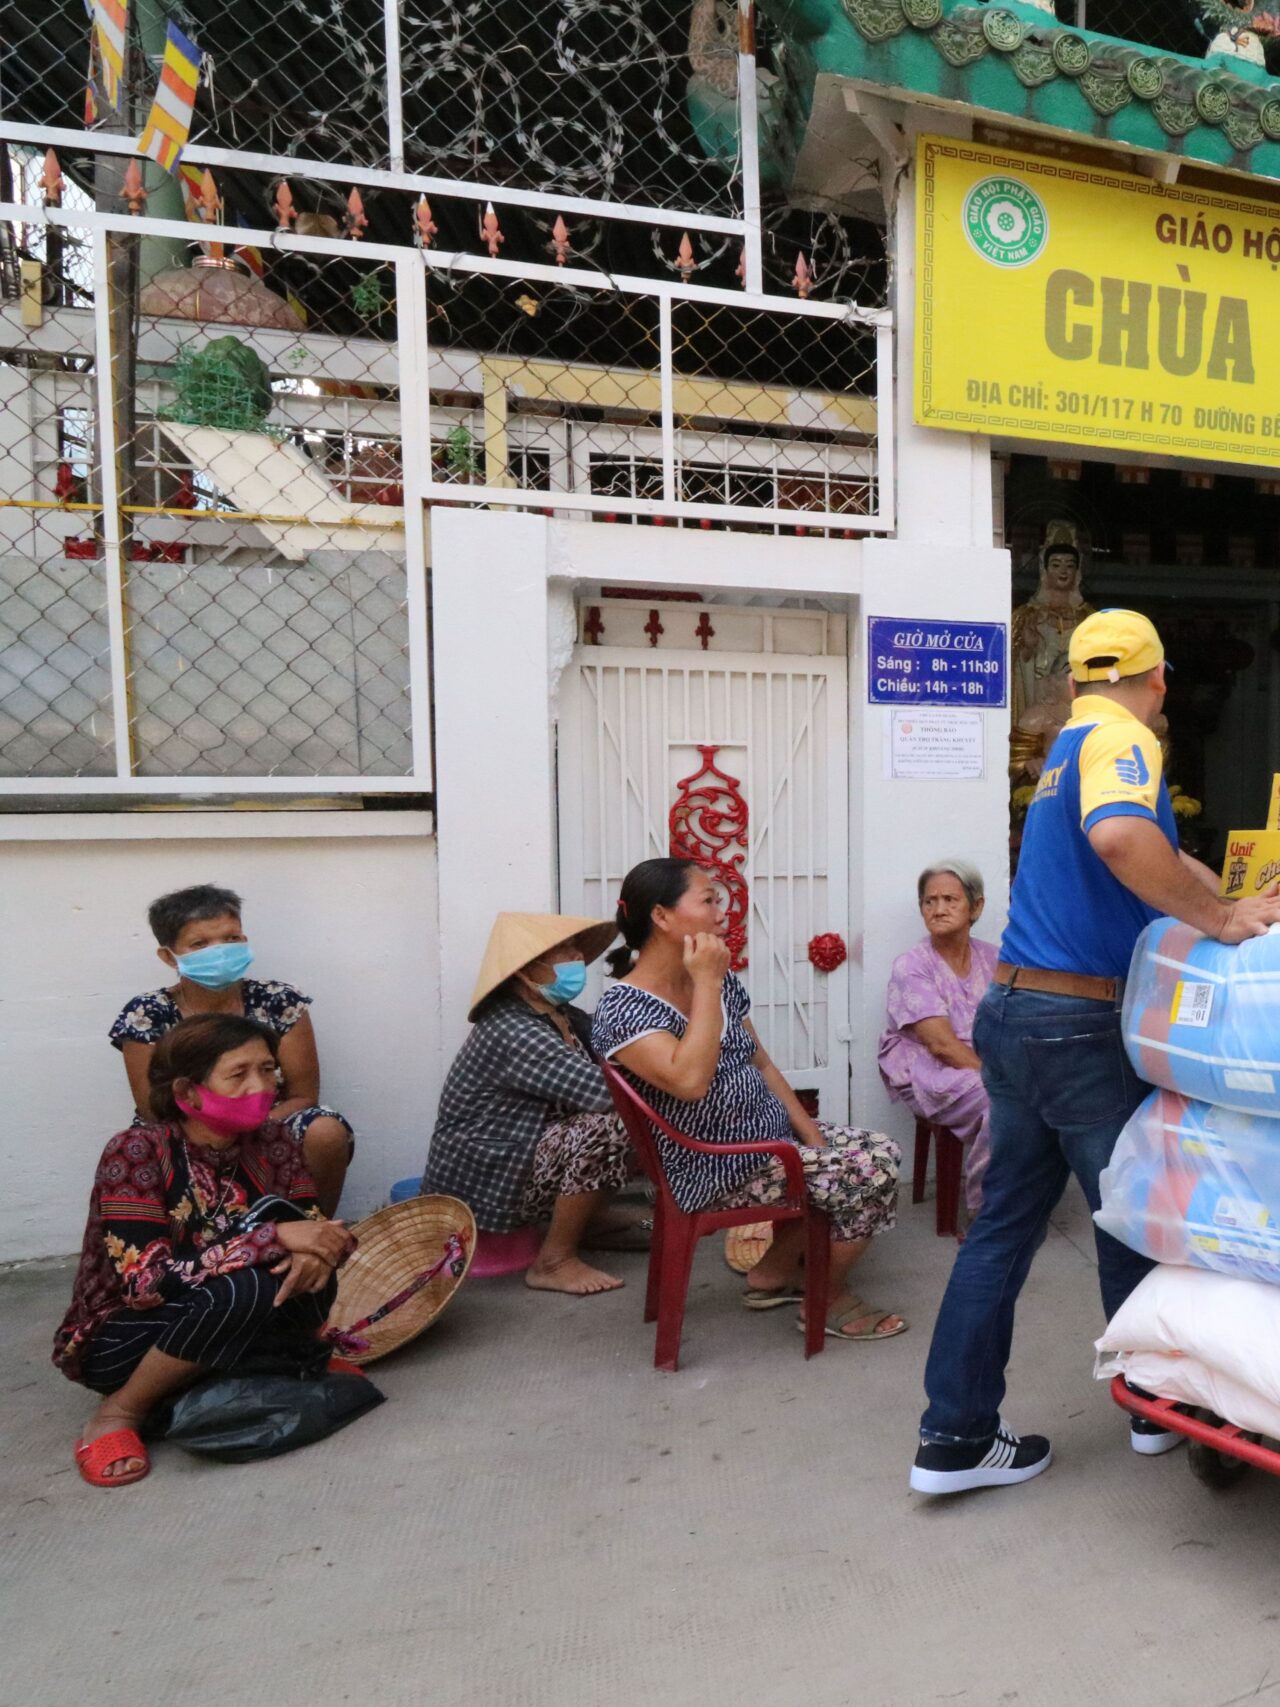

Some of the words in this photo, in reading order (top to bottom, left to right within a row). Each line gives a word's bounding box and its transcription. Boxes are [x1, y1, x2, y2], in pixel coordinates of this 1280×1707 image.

[1155, 211, 1233, 254] GIÁO
[1044, 263, 1255, 385] CHÙA
[966, 378, 1002, 409] ĐỊA
[1055, 390, 1135, 421] 301/117
[1140, 401, 1153, 423] H
[1160, 402, 1183, 427] 70
[893, 628, 924, 647] GIỜ
[926, 629, 951, 648] MỞ
[953, 631, 984, 650] CỬA
[877, 655, 912, 674] Sáng
[931, 658, 948, 672] 8h
[960, 660, 999, 674] 11h30
[925, 681, 948, 694] 14h
[961, 681, 984, 695] 18h
[1230, 842, 1256, 857] Unif
